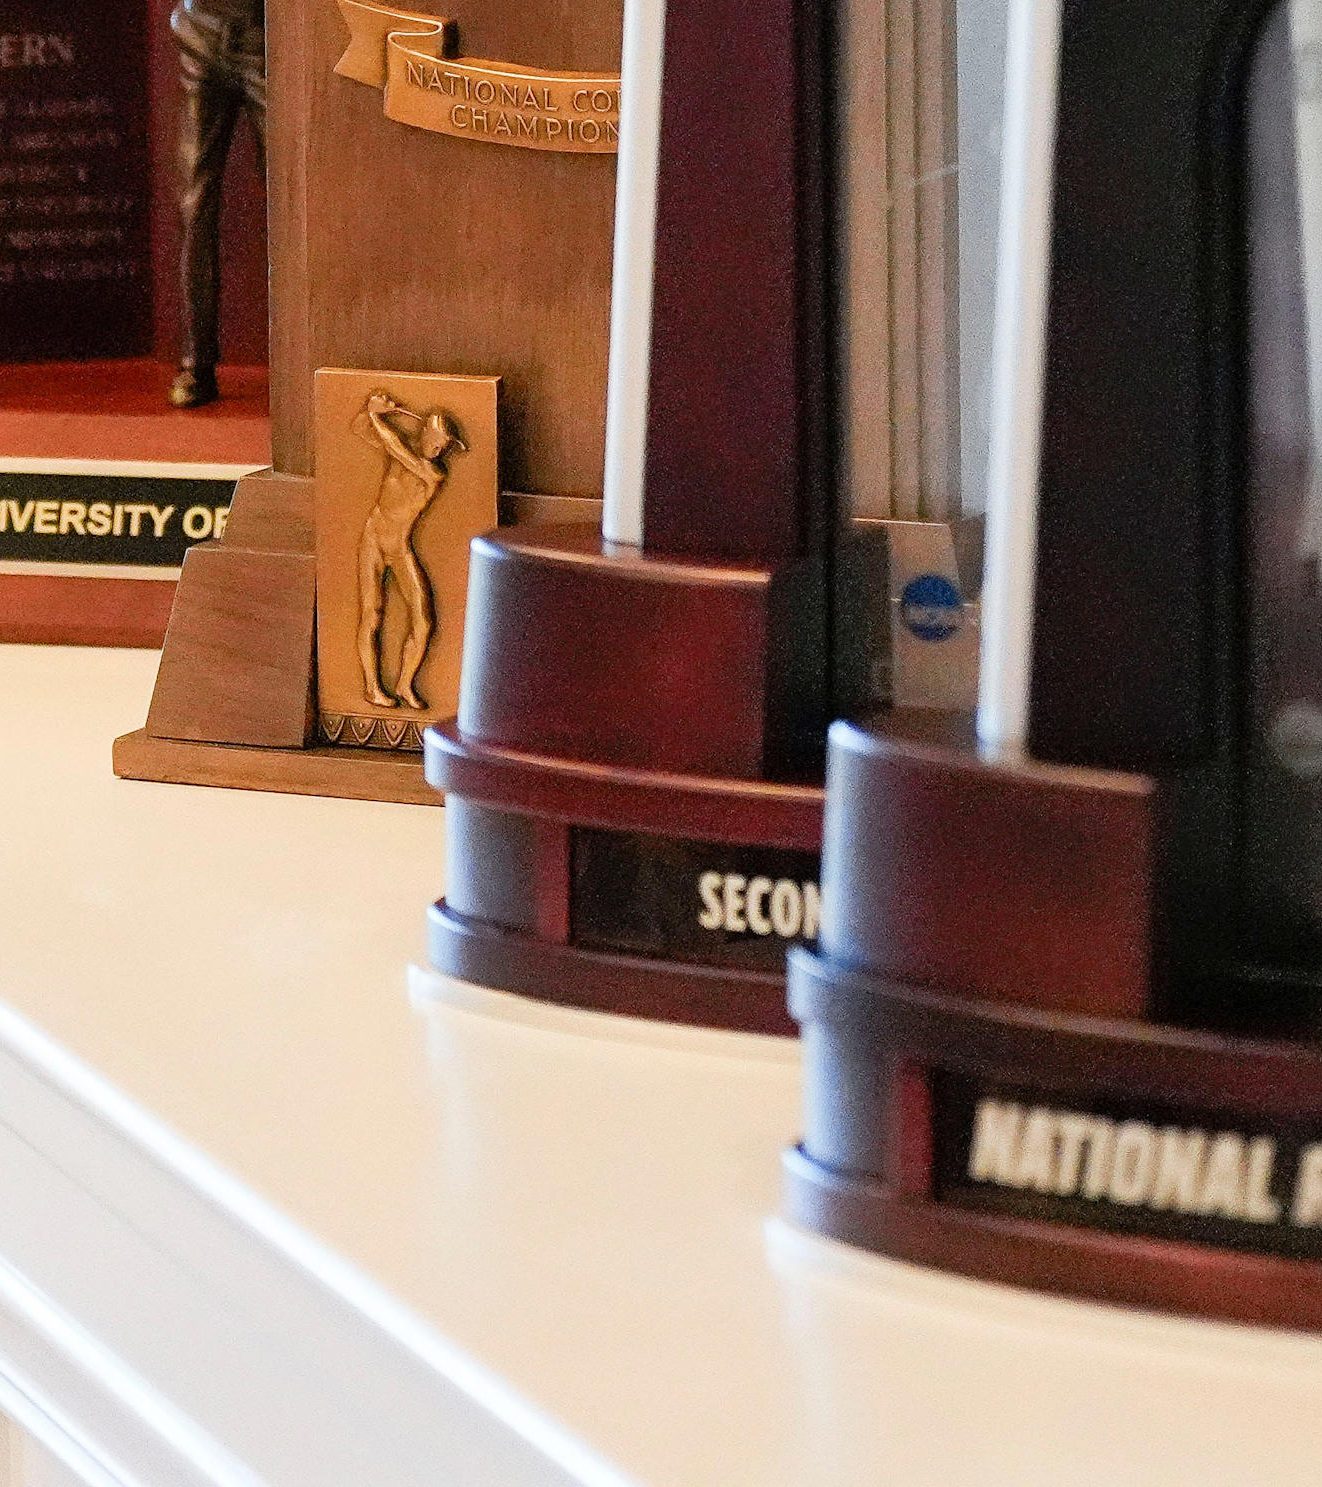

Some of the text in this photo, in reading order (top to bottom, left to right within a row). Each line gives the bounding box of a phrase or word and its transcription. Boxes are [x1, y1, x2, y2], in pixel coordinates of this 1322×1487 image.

[405, 59, 560, 112] NATIONAL
[182, 505, 230, 539] OF
[967, 1099, 1281, 1224] NATIONAL
